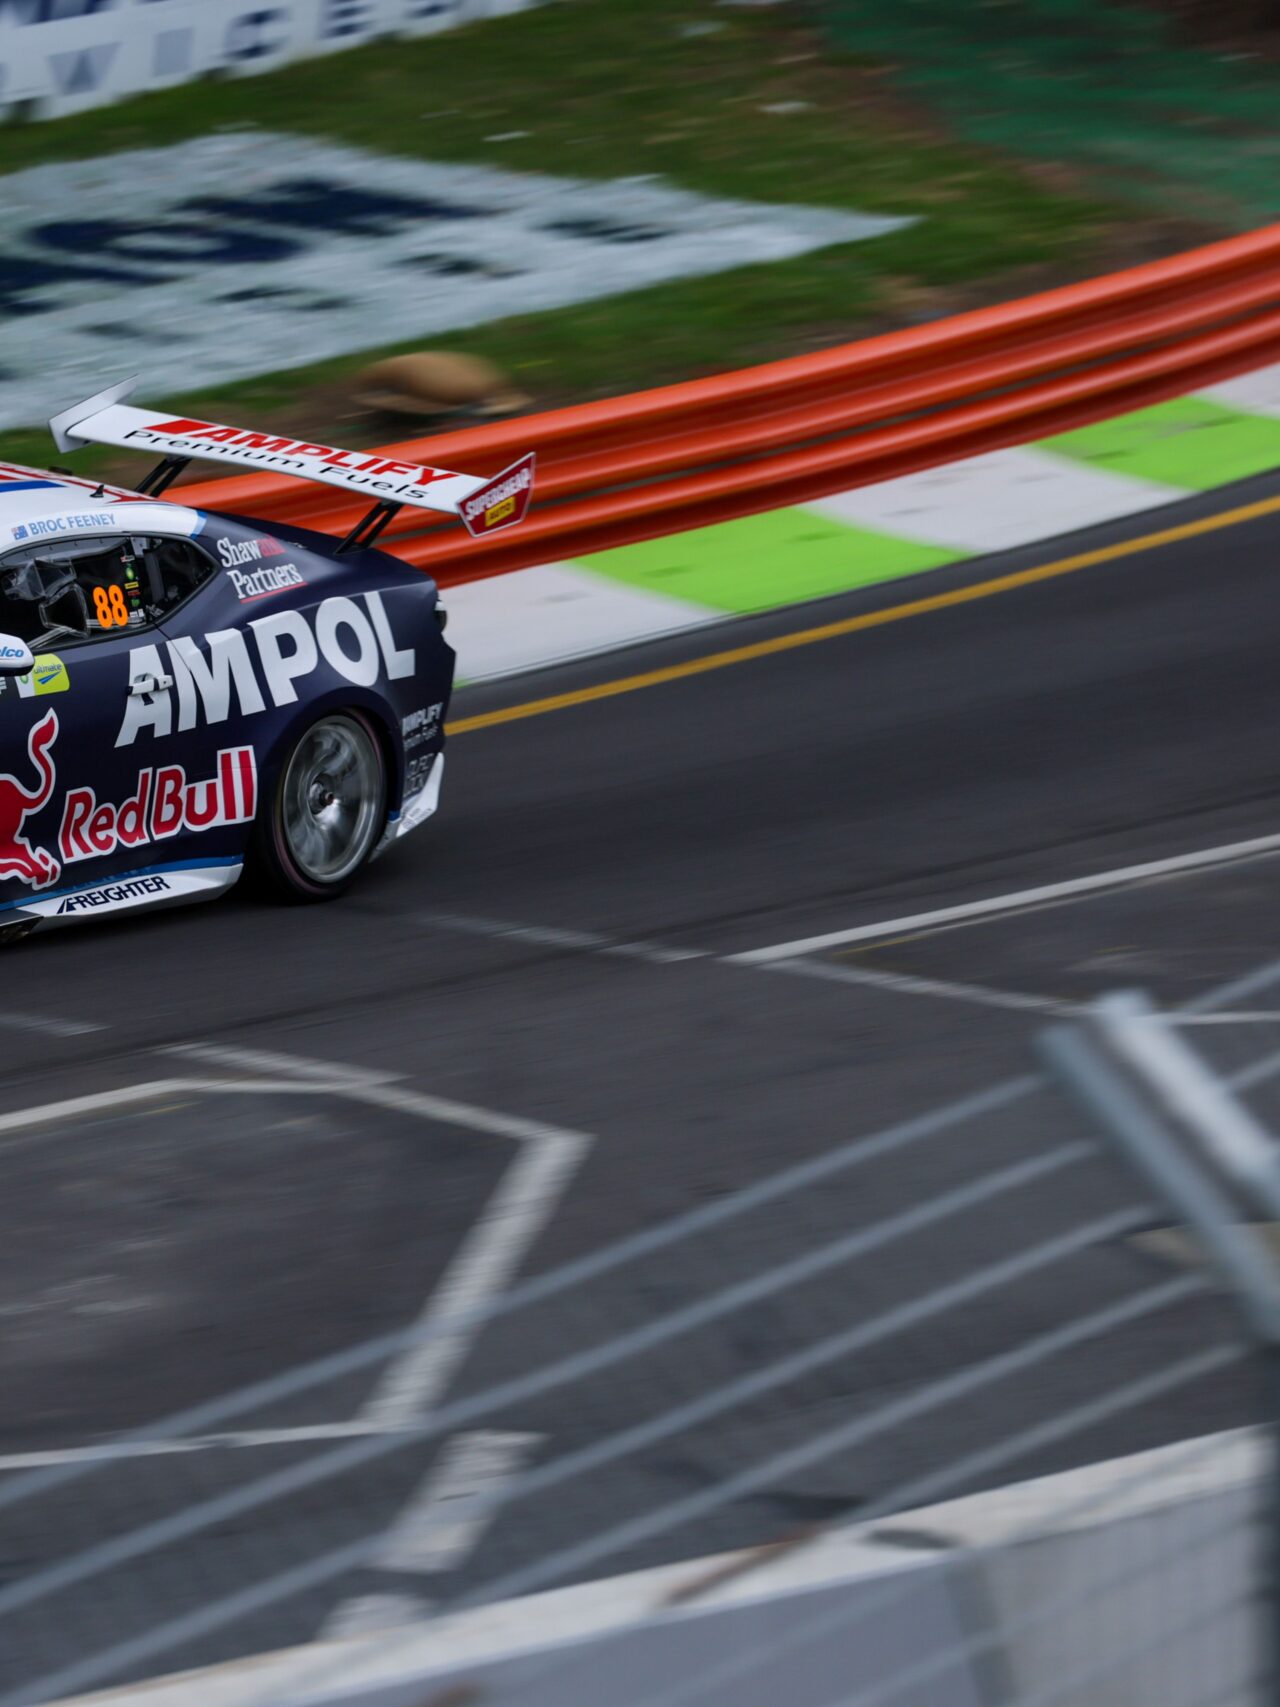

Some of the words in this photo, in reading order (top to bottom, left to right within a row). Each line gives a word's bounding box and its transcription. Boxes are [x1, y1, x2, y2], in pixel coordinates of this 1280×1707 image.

[123, 430, 306, 469] Premium
[319, 465, 430, 501] Fuels
[187, 426, 460, 487] AMPLIFY
[29, 517, 67, 535] BROC
[68, 513, 116, 529] FEENEY
[218, 537, 262, 568] Shaw
[226, 563, 304, 599] Partners
[92, 584, 129, 629] 88
[114, 592, 416, 749] AMPOL
[58, 876, 171, 914] FREIGHTER
